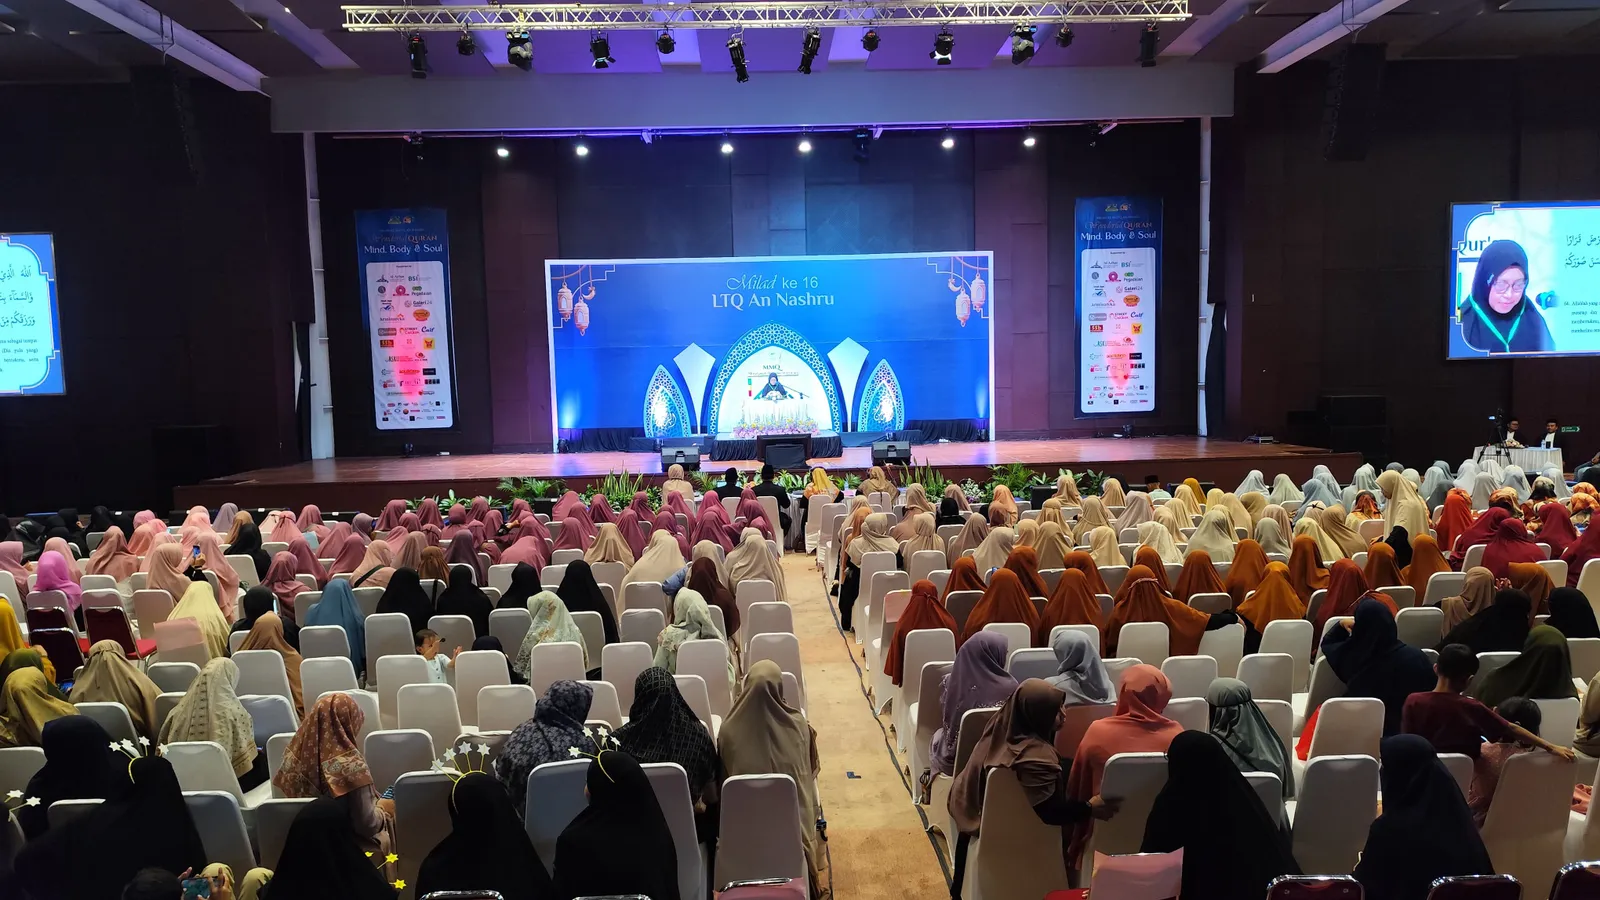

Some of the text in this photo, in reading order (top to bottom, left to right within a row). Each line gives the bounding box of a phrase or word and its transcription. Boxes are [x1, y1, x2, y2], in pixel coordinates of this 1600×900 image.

[1106, 232, 1126, 242] Body
[1129, 231, 1135, 239] &
[390, 245, 411, 255] Body
[414, 244, 420, 252] &
[424, 244, 442, 252] Soul
[726, 275, 818, 290] Milad ke 16
[712, 292, 834, 311] LTQ An Nashru
